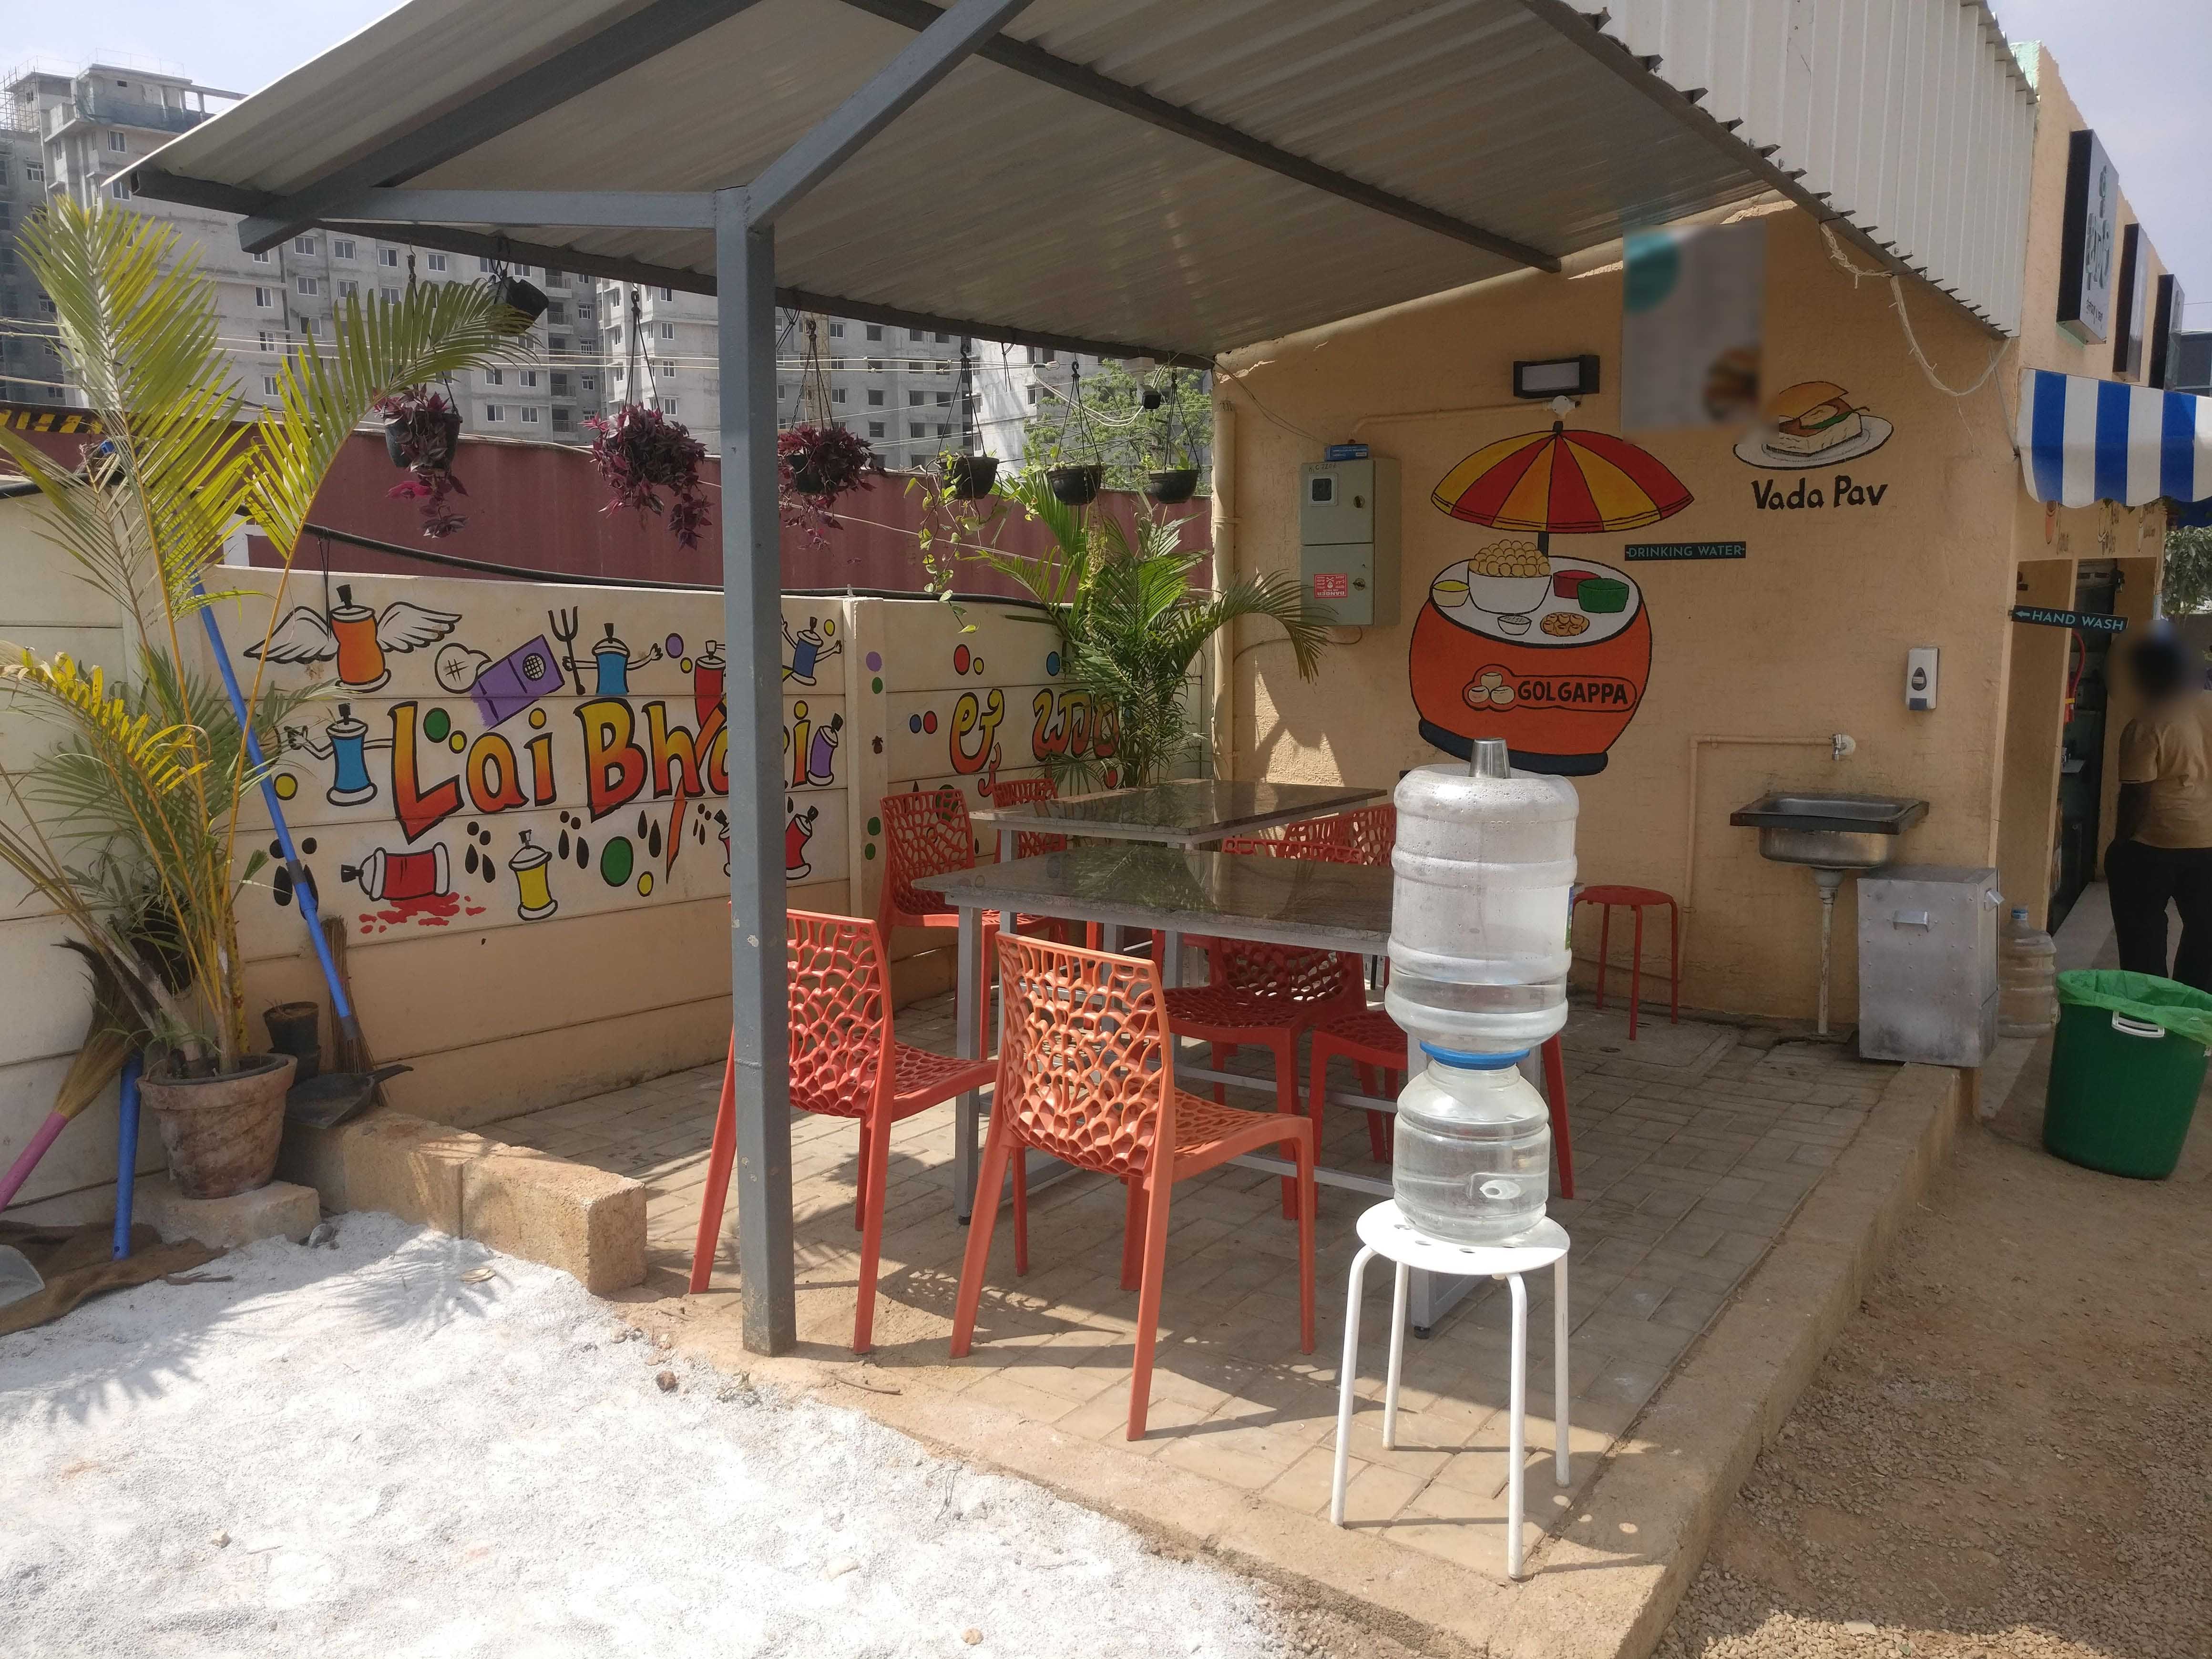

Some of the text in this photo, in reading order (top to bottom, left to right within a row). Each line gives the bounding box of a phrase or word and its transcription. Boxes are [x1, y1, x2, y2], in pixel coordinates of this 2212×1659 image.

[1751, 475, 1888, 510] Vada Pav
[1628, 545, 1742, 557] DRINKING WATER
[2032, 610, 2124, 631] HAND WASH
[1517, 680, 1628, 705] GOLGAPPA
[387, 697, 811, 844] Lai Bhi
